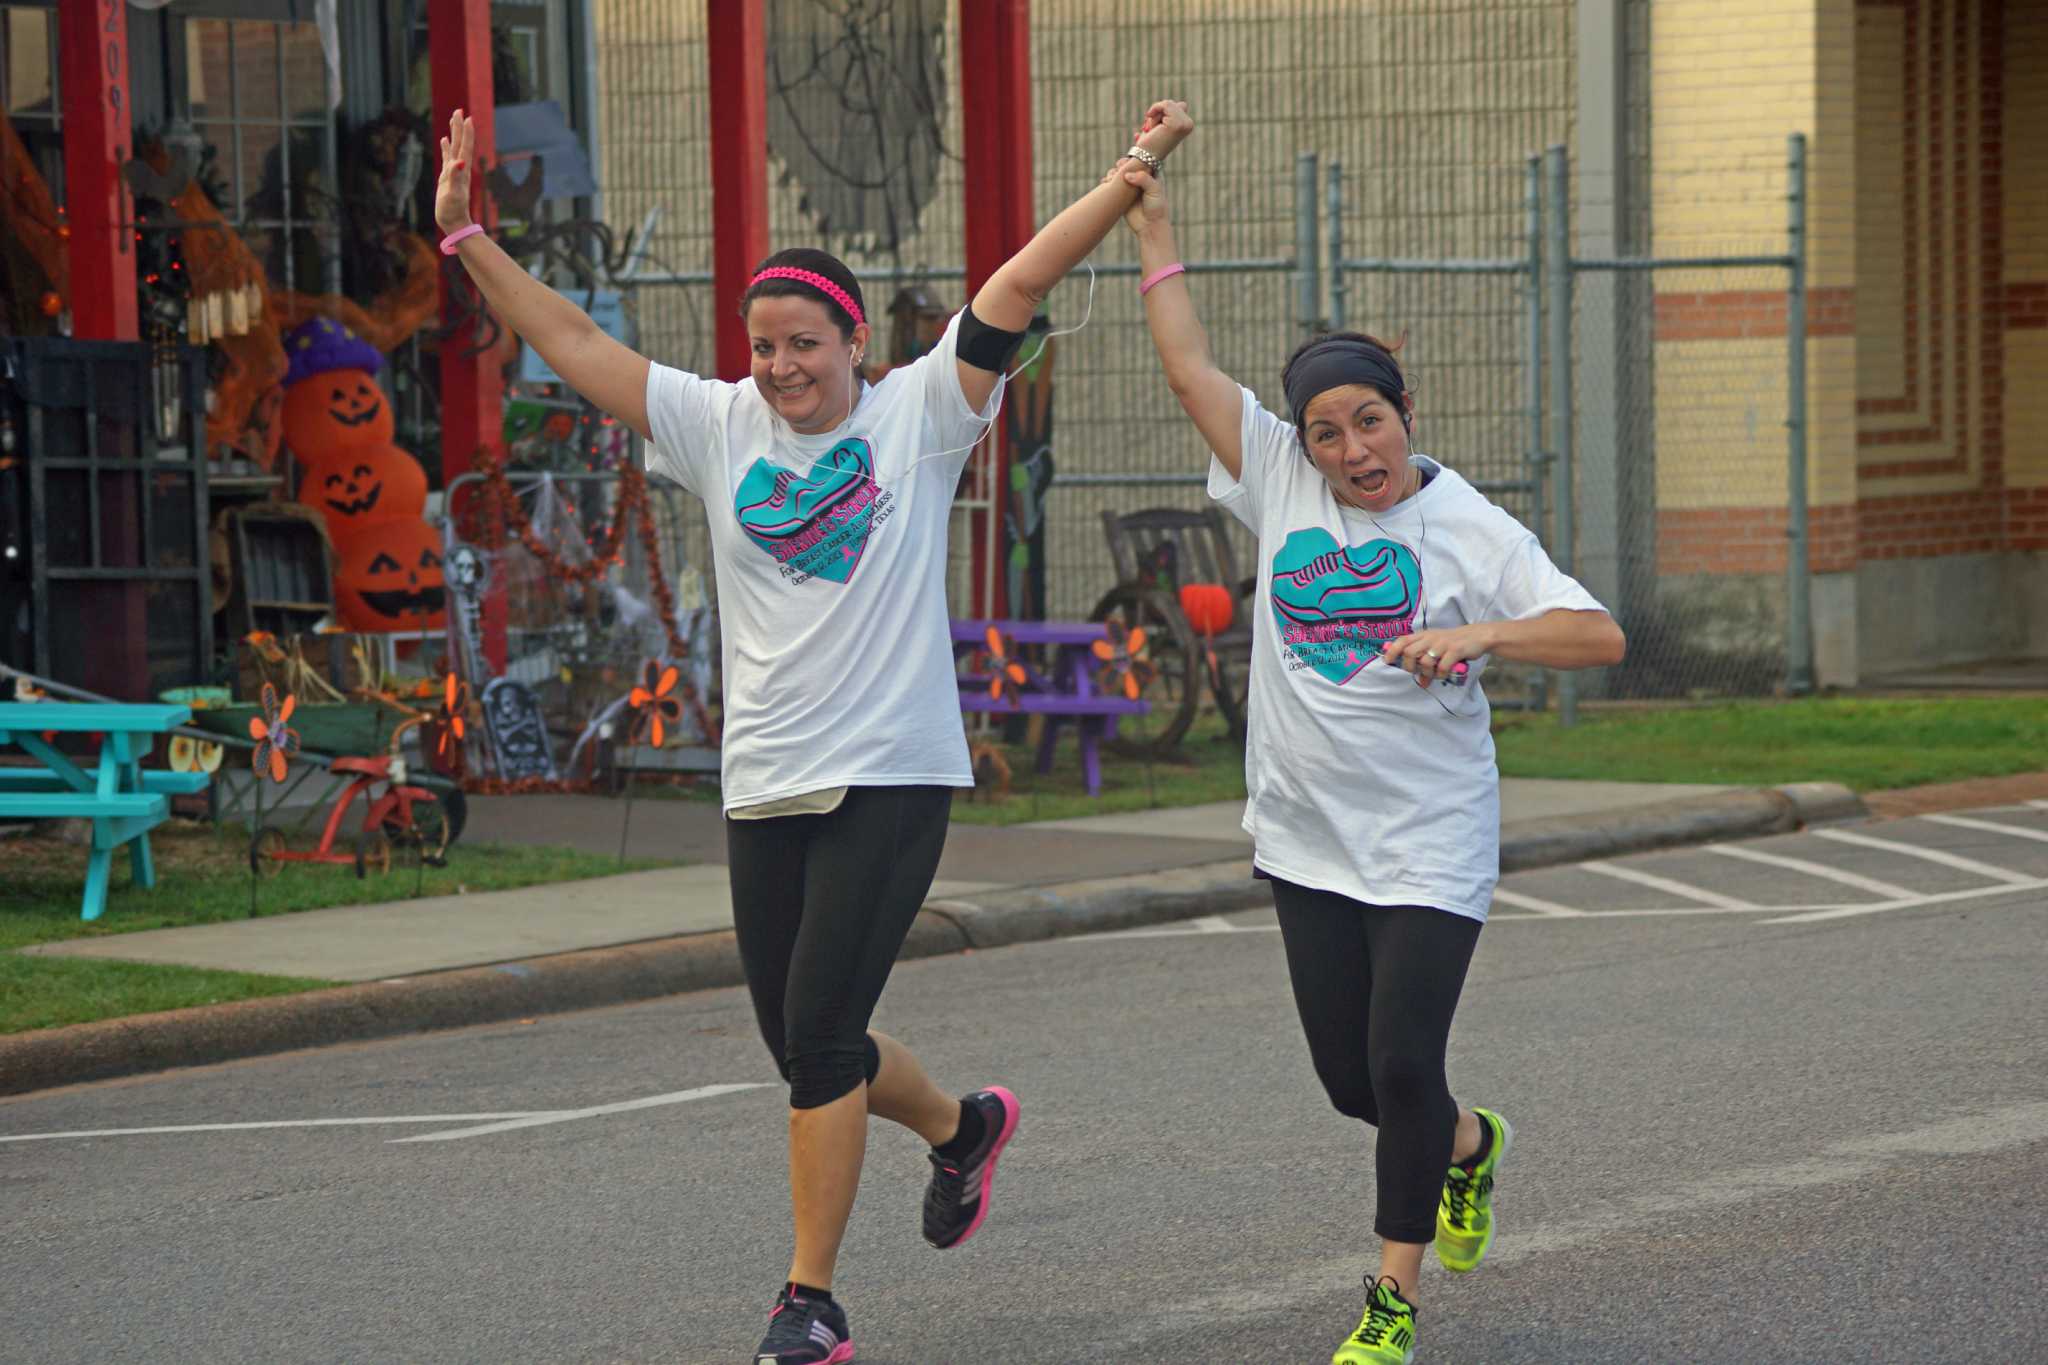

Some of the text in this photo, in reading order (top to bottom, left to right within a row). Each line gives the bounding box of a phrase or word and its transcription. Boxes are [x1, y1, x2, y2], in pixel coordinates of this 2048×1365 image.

[830, 479, 883, 525] STRIDE
[875, 504, 896, 525] TEXAS
[779, 564, 797, 578] FOR
[822, 529, 851, 552] CANCER
[850, 490, 894, 531] AWARENESS
[1357, 618, 1414, 639] STRIDE
[1330, 640, 1364, 654] CANCER
